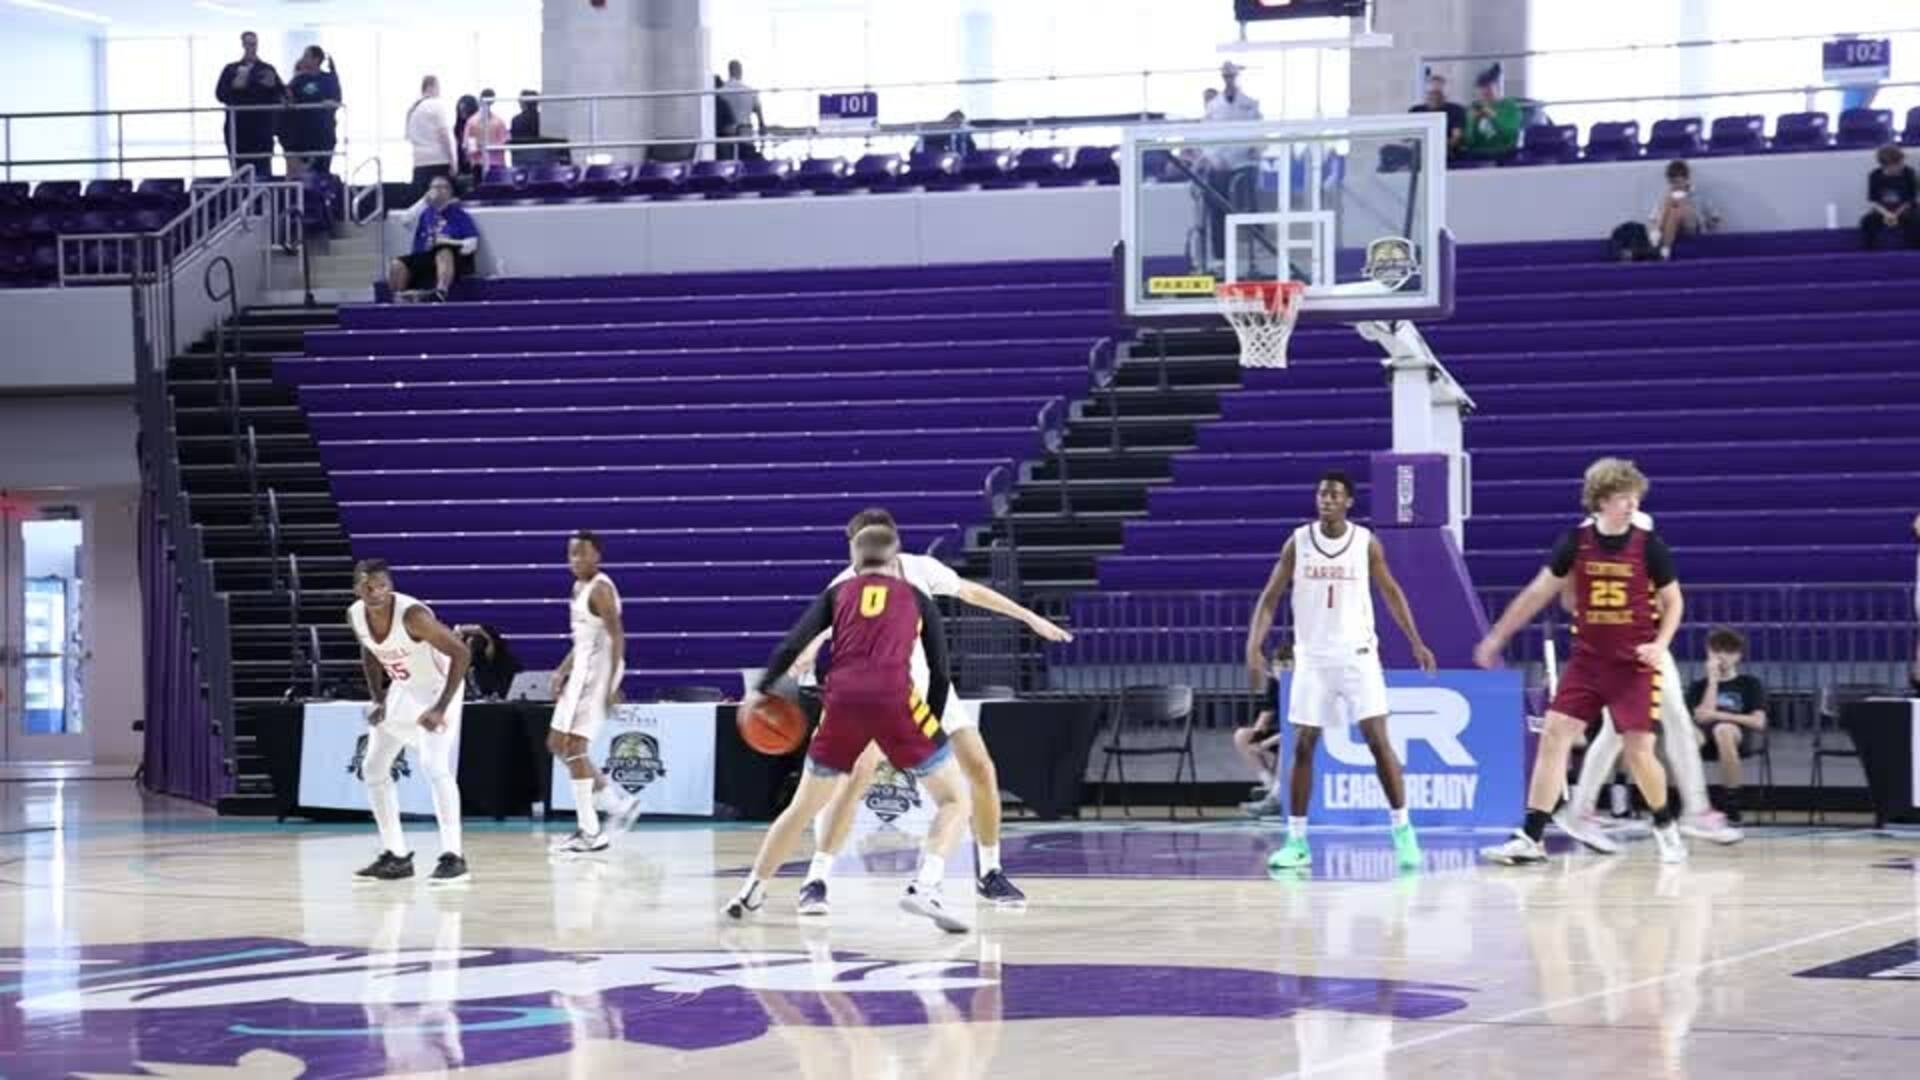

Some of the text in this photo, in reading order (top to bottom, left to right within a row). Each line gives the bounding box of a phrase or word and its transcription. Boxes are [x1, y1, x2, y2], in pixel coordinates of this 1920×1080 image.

[1846, 43, 1882, 62] 102
[841, 95, 868, 113] 101
[860, 585, 888, 618] 0
[1327, 583, 1334, 609] 1
[1590, 580, 1627, 607] 25
[1324, 773, 1479, 810] LEAG READY
